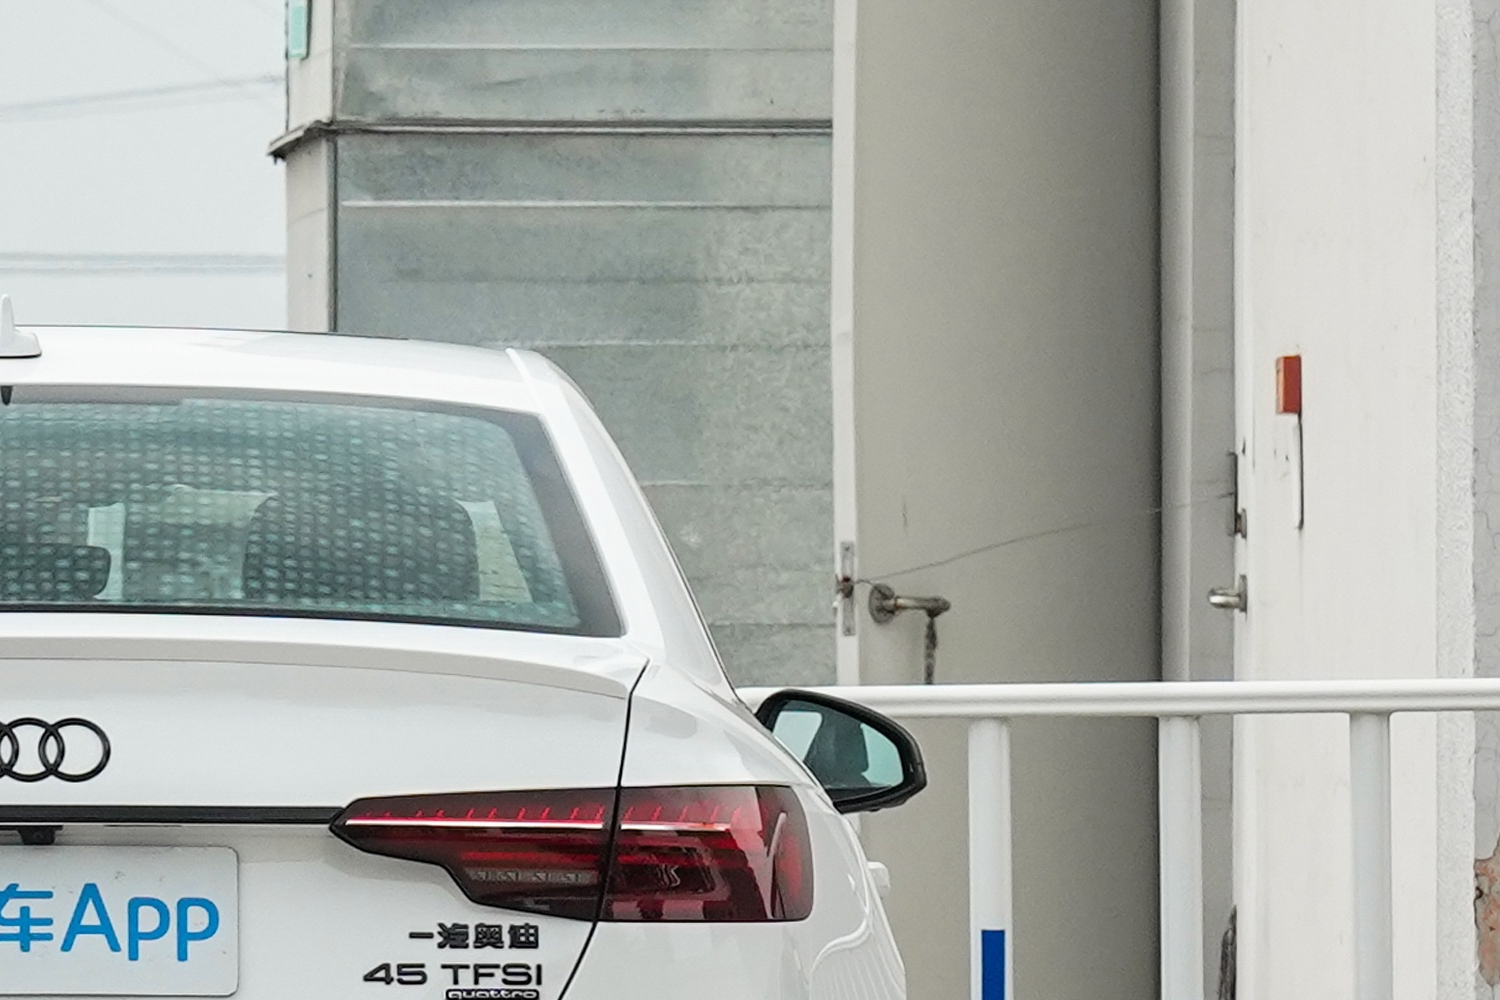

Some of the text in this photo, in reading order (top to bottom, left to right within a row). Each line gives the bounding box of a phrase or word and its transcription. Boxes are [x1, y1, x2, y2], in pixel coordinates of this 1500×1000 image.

[408, 923, 540, 949] 一汽奥迪
[363, 963, 543, 985] 45 TFSI
[447, 989, 538, 1000] quattro
